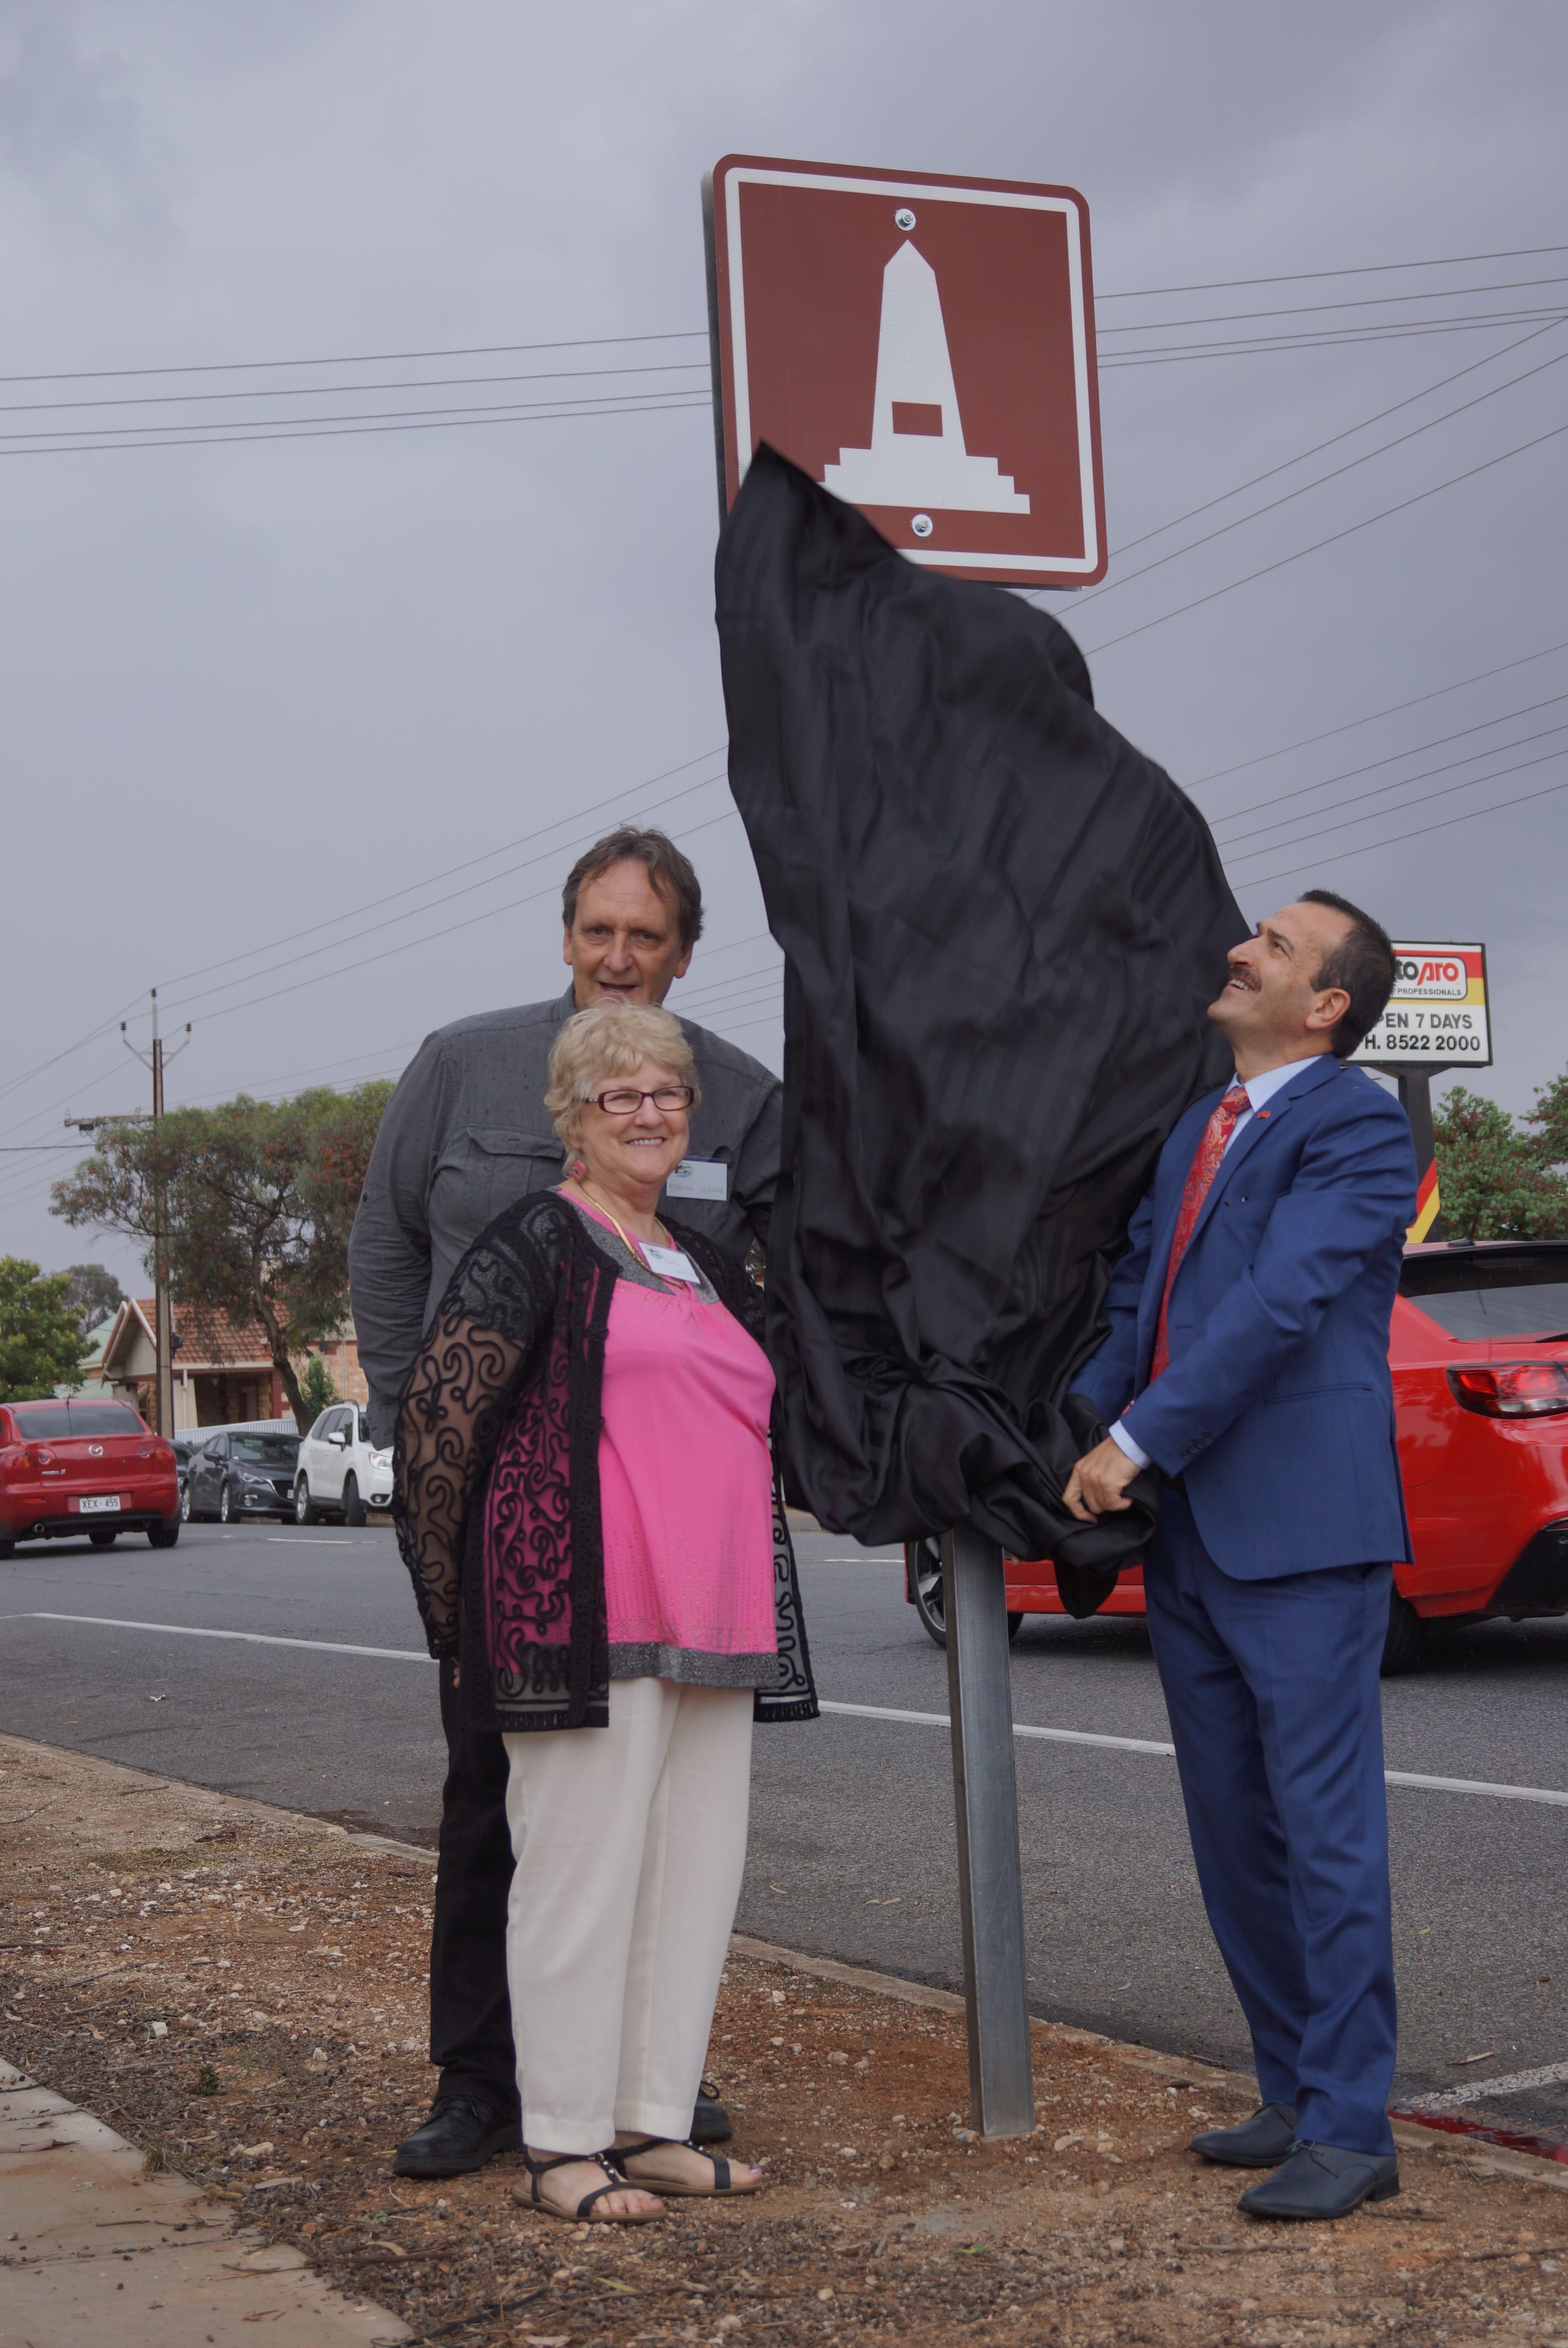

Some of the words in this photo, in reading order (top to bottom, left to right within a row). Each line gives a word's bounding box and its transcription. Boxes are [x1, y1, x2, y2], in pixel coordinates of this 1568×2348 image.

[1415, 1013, 1425, 1028] 7
[1430, 1013, 1473, 1029] DAYS
[1386, 1034, 1430, 1050] 8522
[1436, 1035, 1481, 1051] 2000
[82, 1500, 98, 1508] XEX
[105, 1499, 118, 1507] 455
